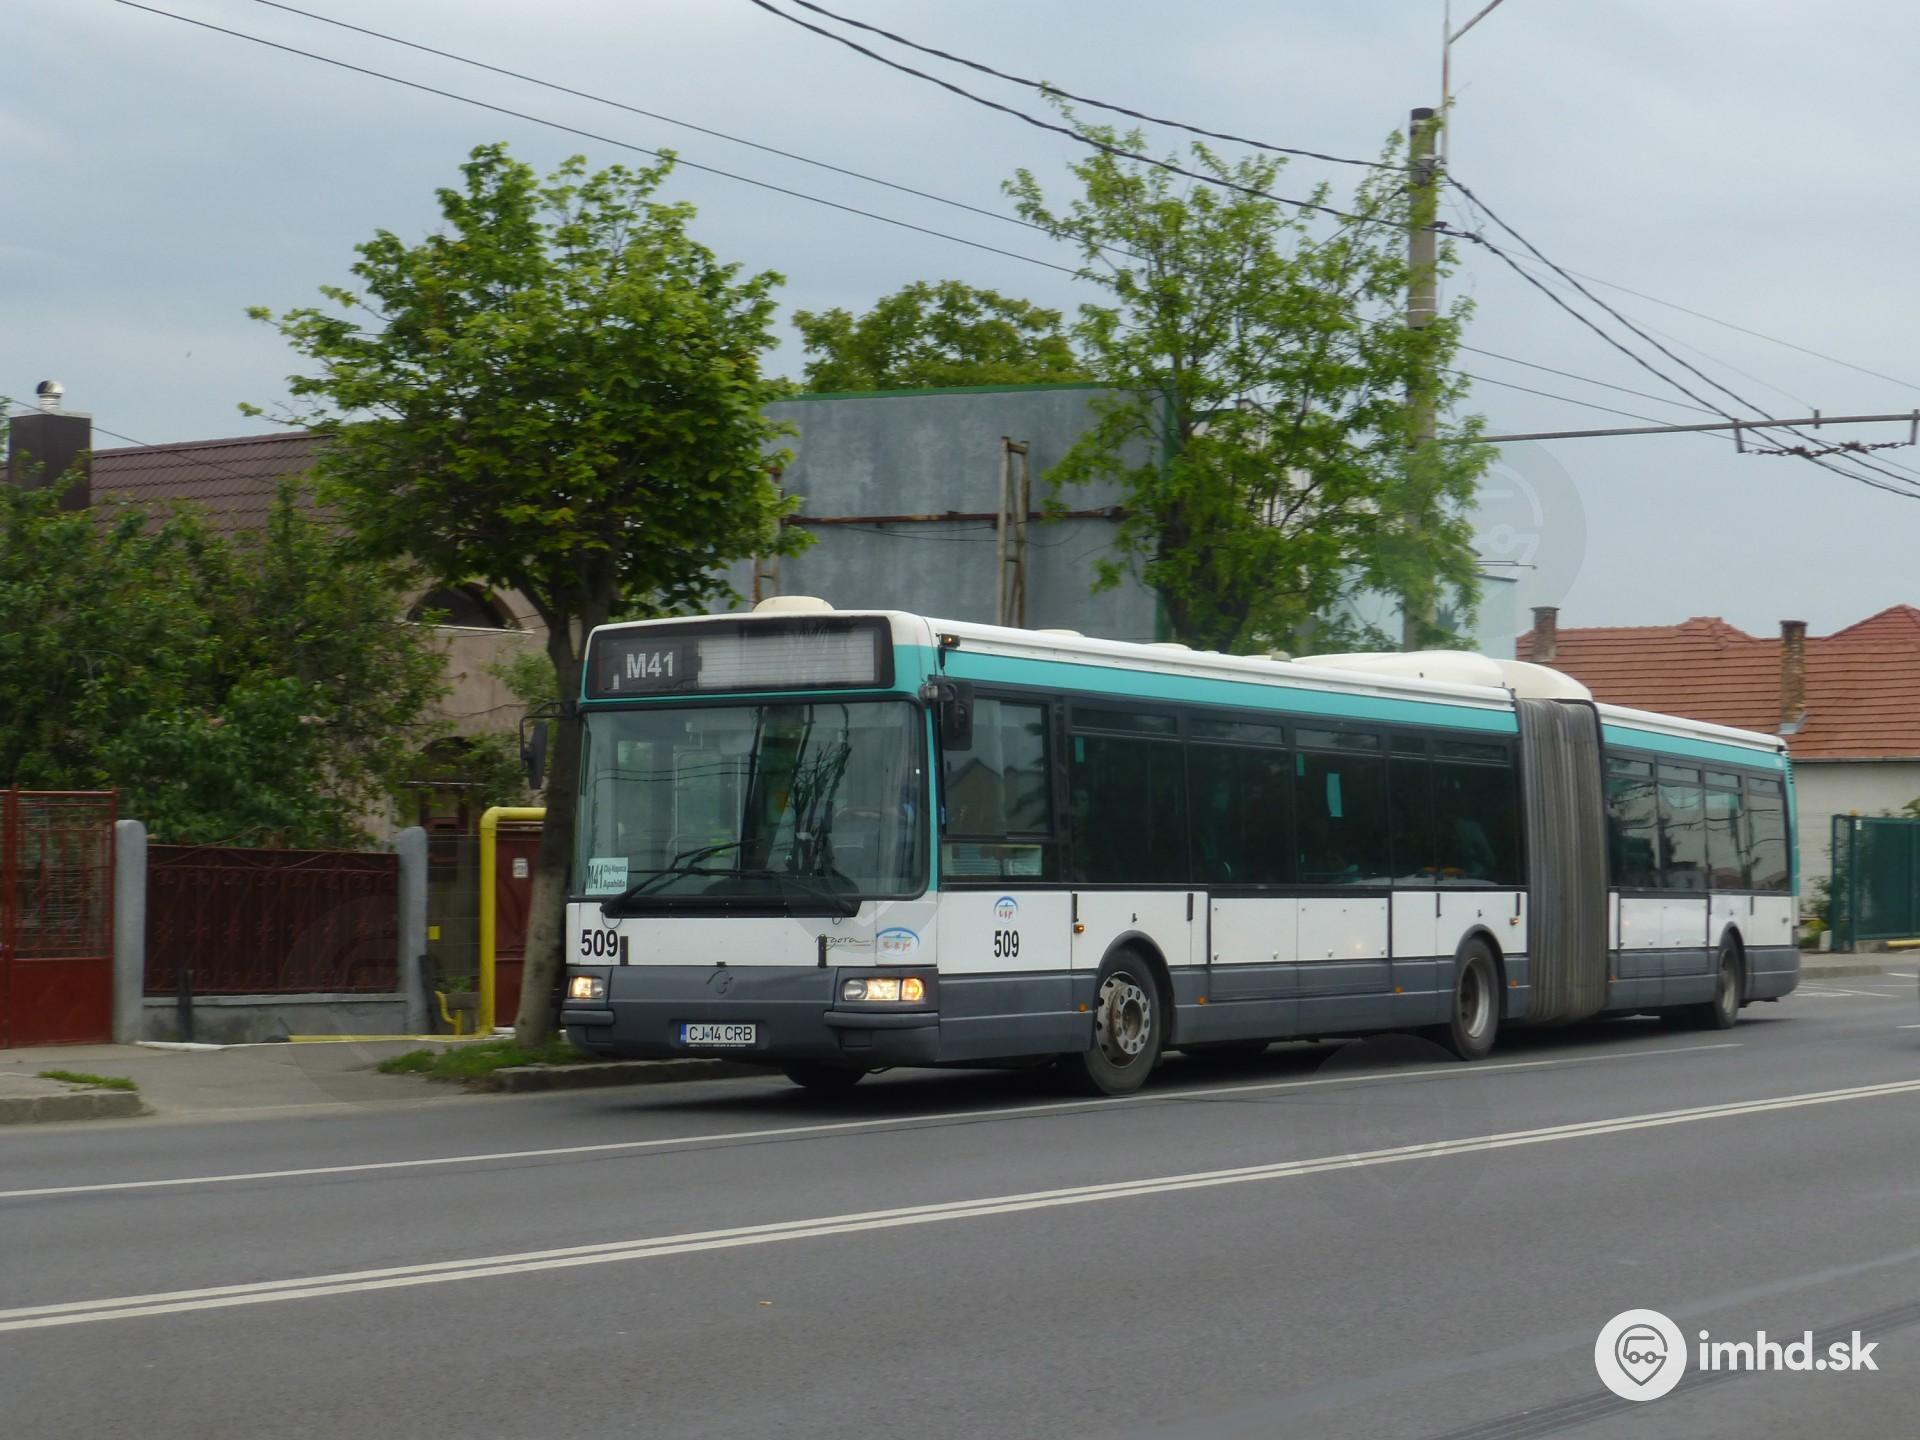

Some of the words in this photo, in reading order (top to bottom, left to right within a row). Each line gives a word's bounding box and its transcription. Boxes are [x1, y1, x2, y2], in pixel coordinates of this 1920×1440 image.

[626, 652, 673, 679] M41
[586, 864, 603, 888] M41
[580, 929, 618, 957] 509
[993, 930, 1020, 958] 509
[689, 1026, 705, 1041] CJ
[709, 1026, 721, 1041] 14
[724, 1026, 753, 1041] CRB
